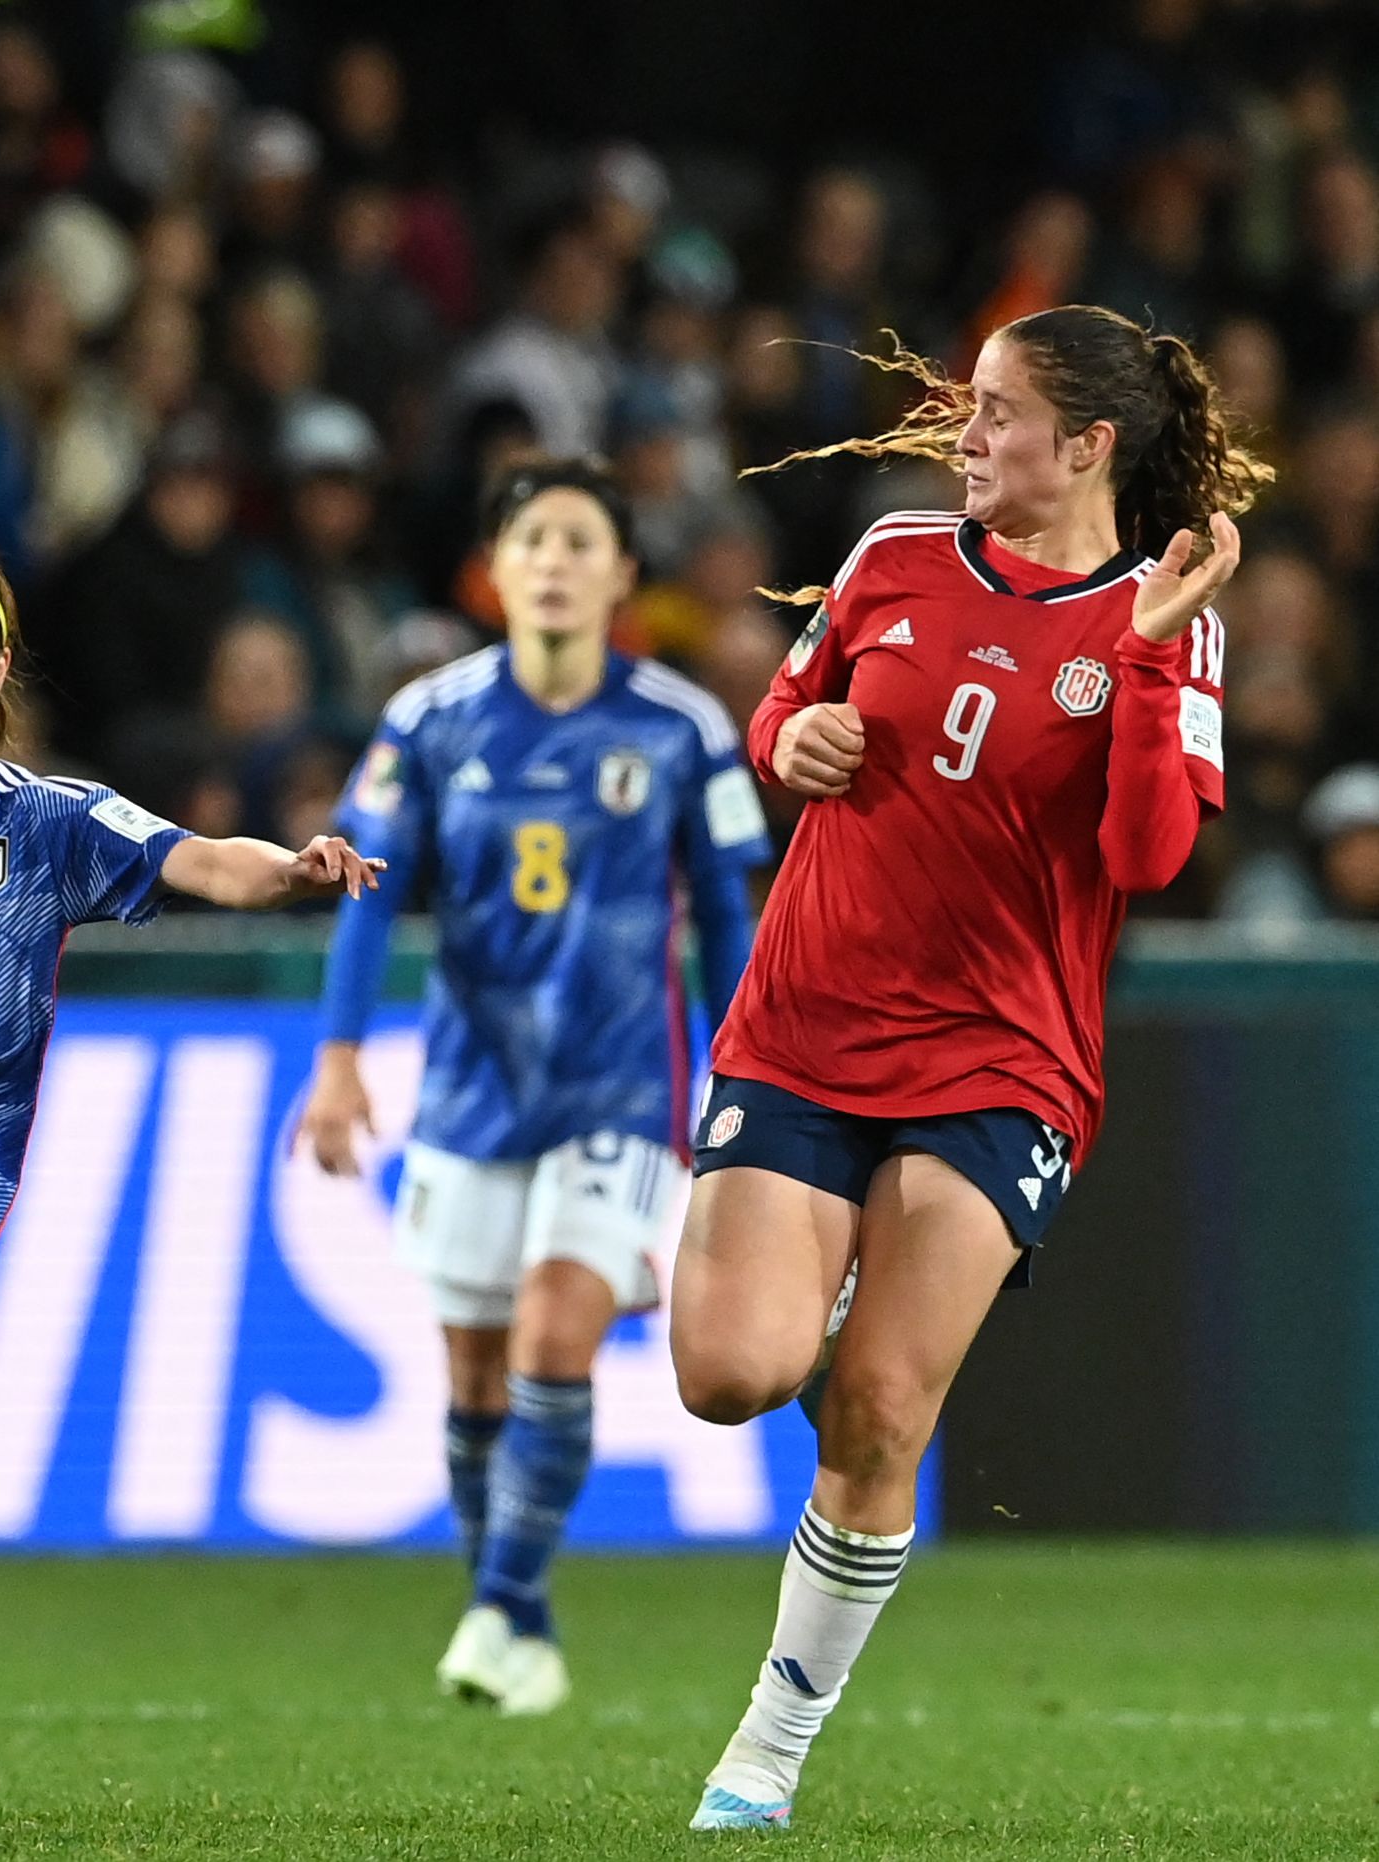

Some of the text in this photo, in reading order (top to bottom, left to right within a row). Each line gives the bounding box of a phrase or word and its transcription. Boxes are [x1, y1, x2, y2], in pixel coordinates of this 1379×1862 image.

[933, 683, 997, 780] 9
[1064, 668, 1100, 706] CR
[512, 821, 570, 913] 8
